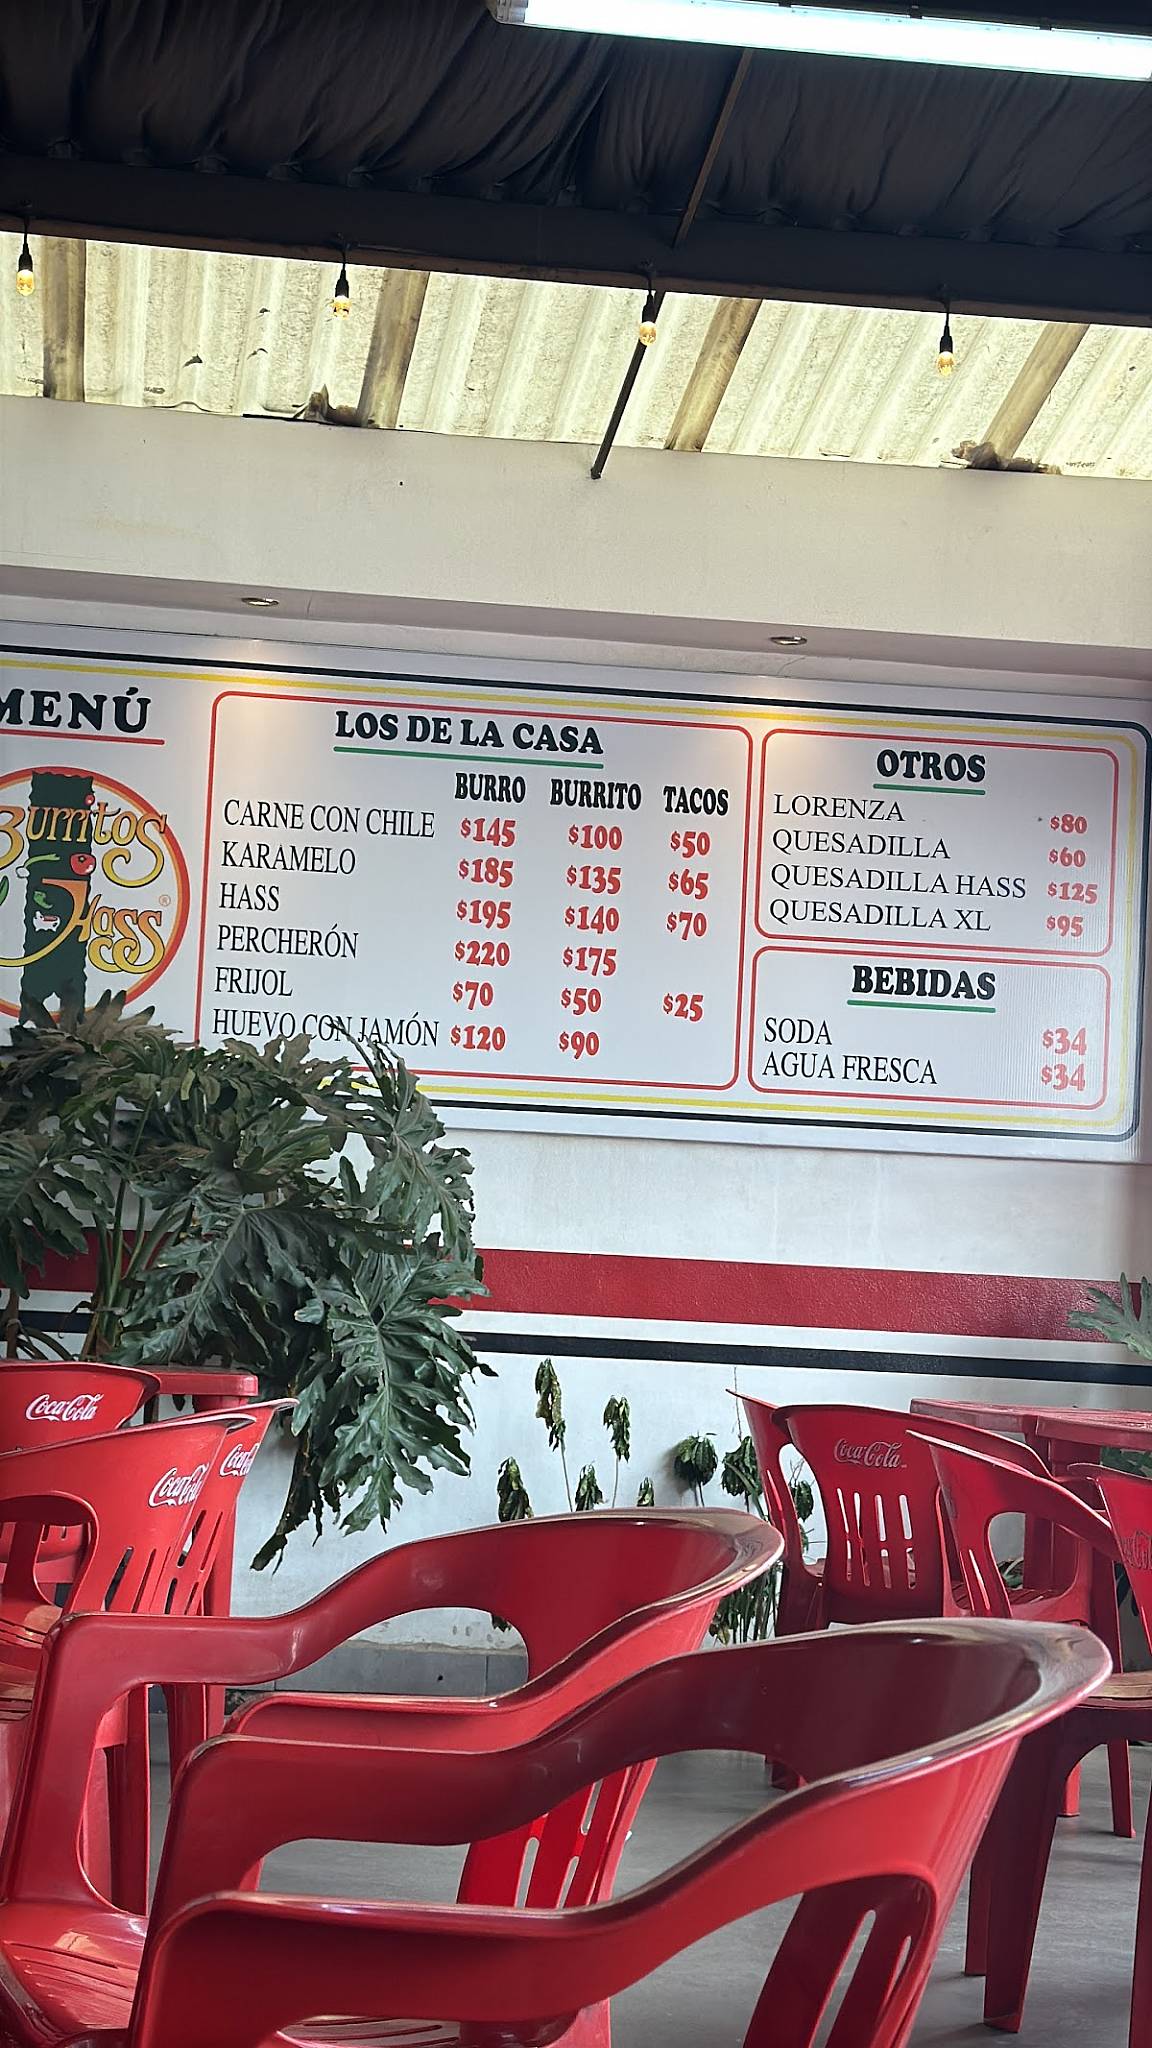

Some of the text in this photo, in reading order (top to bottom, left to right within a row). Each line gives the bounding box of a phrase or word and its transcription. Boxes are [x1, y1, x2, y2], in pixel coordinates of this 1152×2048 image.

[335, 711, 603, 754] LOS DE LA CASA
[877, 749, 985, 782] OTROS
[455, 773, 728, 816] BURRO BURRITO TACOS
[773, 794, 1087, 834] LORENZA $80
[224, 799, 711, 860] CARNE CON CHILE $145 $100 $50
[773, 829, 1086, 868] QUESADILLA $60
[221, 841, 710, 901] KARAMELO $185 $135 $65
[772, 864, 1097, 904] QUESADILLA HASS $125
[0, 878, 165, 974] Hass
[219, 883, 708, 941] HASS $195 $140 $70
[770, 899, 1082, 937] QUESADILLA XL $95
[217, 923, 617, 976] PERCHERÓN $220 $175
[214, 967, 703, 1022] FRIJOL $70 $50 $25
[851, 965, 997, 1000] BEBIDAS
[212, 1008, 599, 1059] HUEVO CON JAMÓN $120 $90
[764, 1017, 1087, 1056] SODA $34
[762, 1051, 1085, 1090] AGUA FRESCA $34
